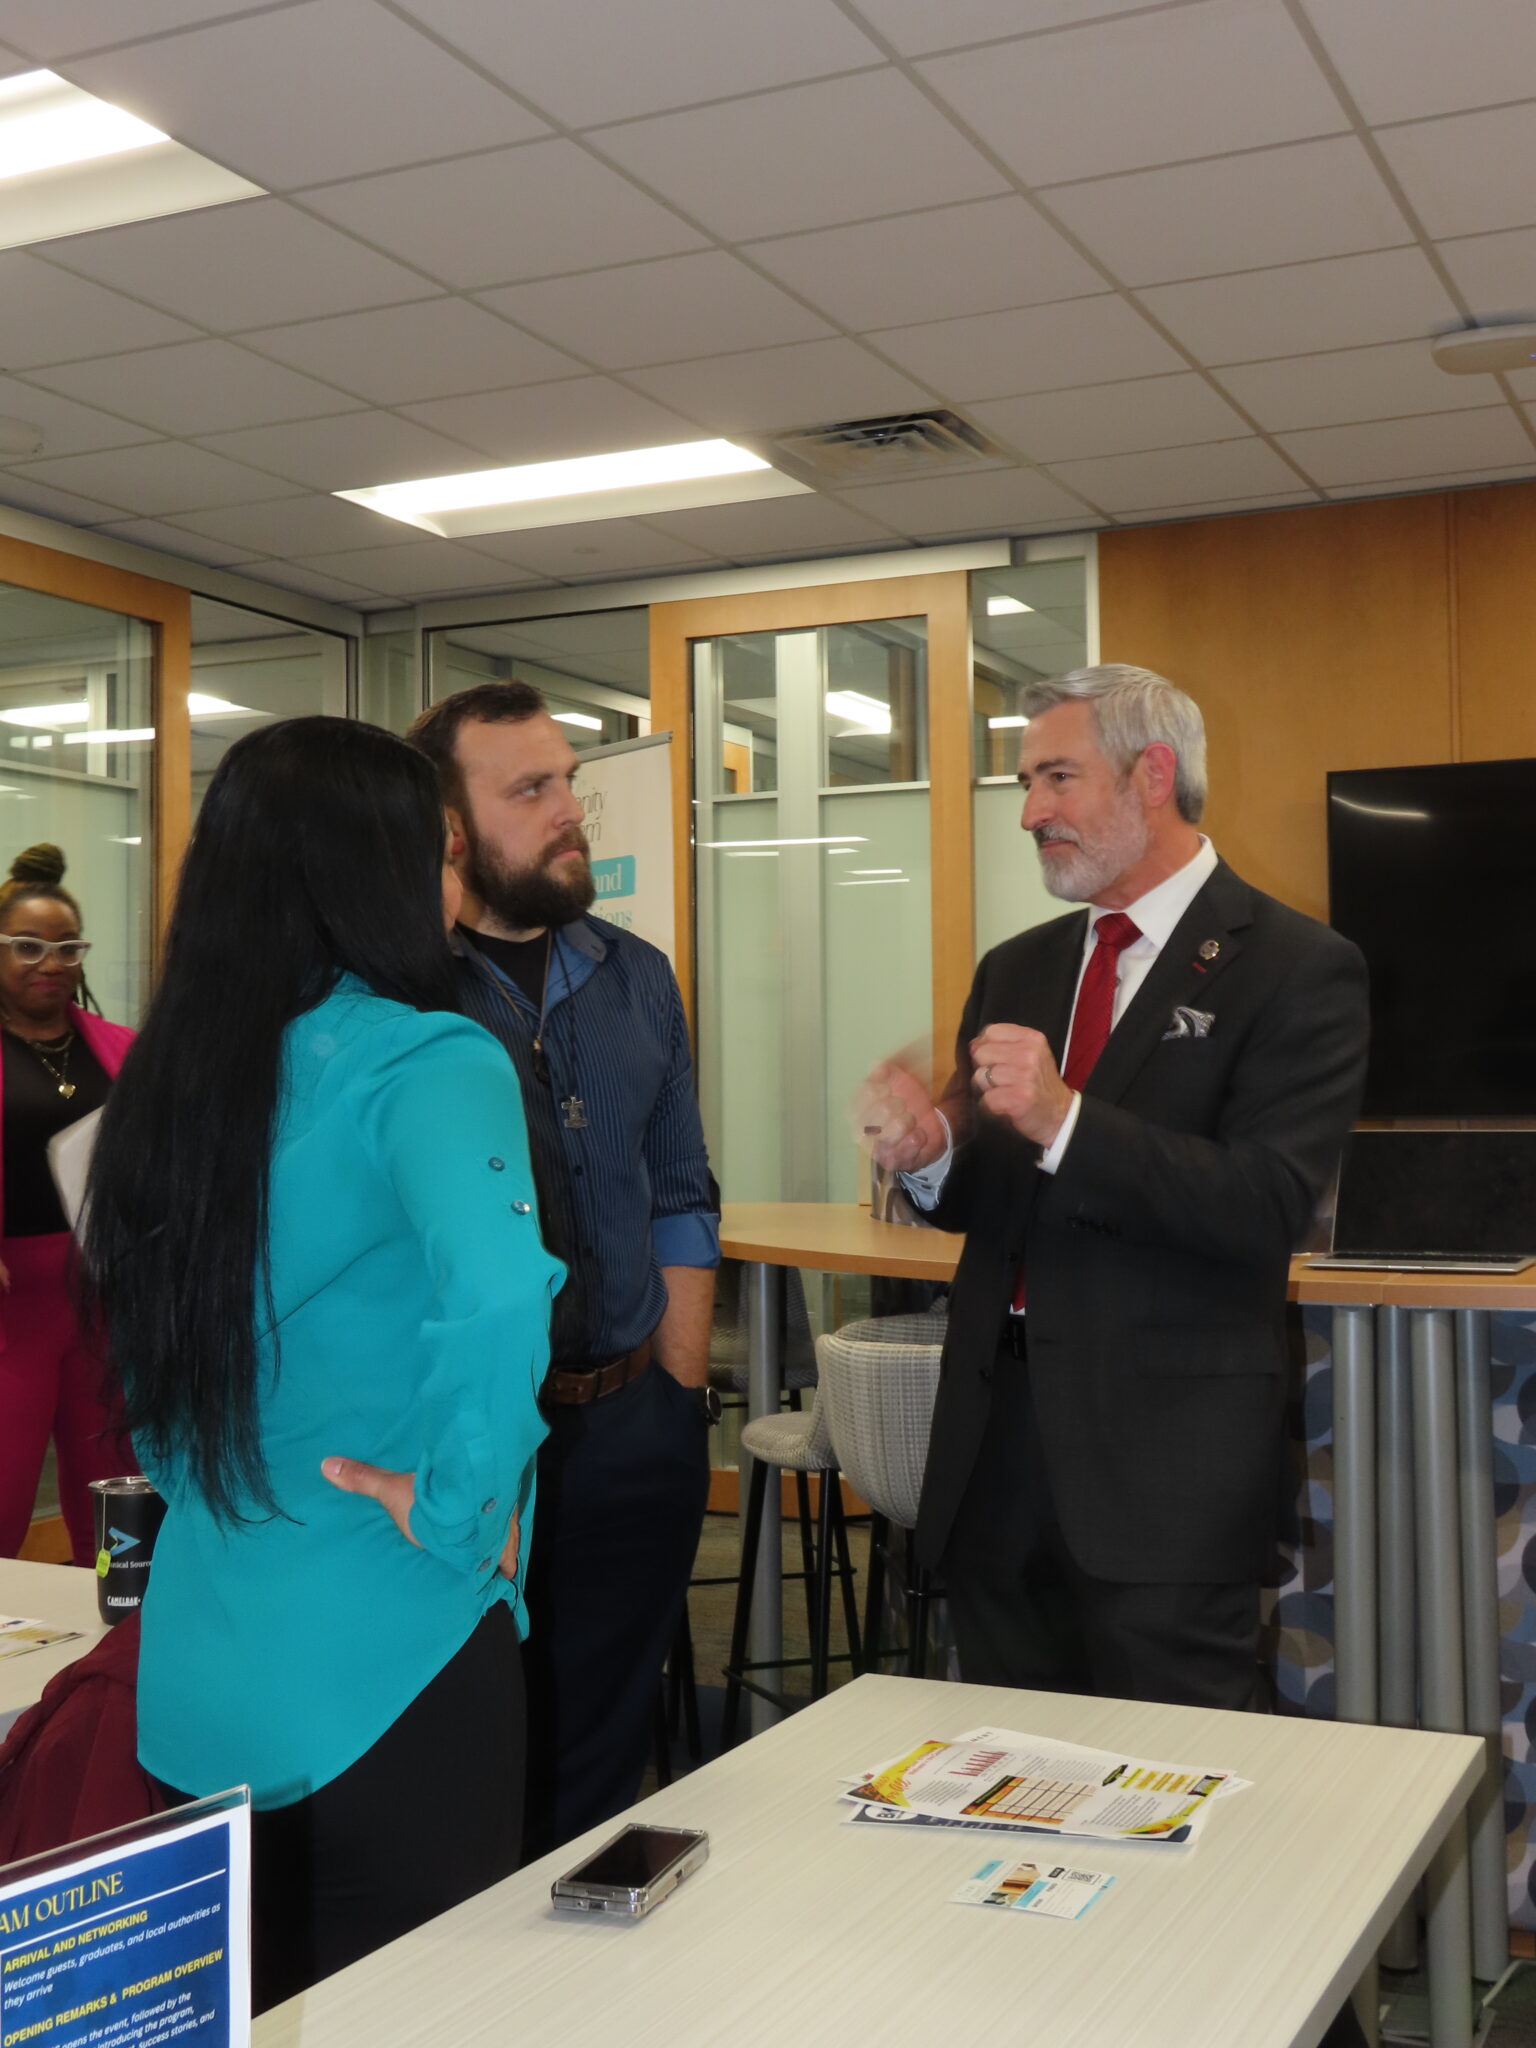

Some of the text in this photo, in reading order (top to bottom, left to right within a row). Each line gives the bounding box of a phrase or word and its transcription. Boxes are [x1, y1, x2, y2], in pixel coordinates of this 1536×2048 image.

[35, 1872, 124, 1921] OUTLINE
[4, 1909, 148, 1973] ARRIVAL AND NETWORKING
[4, 1903, 221, 1993] Welcome guests, graduates, and local authorities as
[4, 1983, 54, 2010] they arrive
[4, 1948, 223, 2047] OPENING REMARKS & PROGRAM OVERVIEW
[89, 2029, 103, 2042] the
[104, 2018, 129, 2036] event,
[131, 2000, 166, 2024] followed
[167, 1997, 178, 2010] by
[178, 1992, 192, 2004] the
[144, 2021, 158, 2033] the
[159, 2006, 194, 2029] program,
[170, 2018, 198, 2037] stories,
[199, 2009, 215, 2024] and
